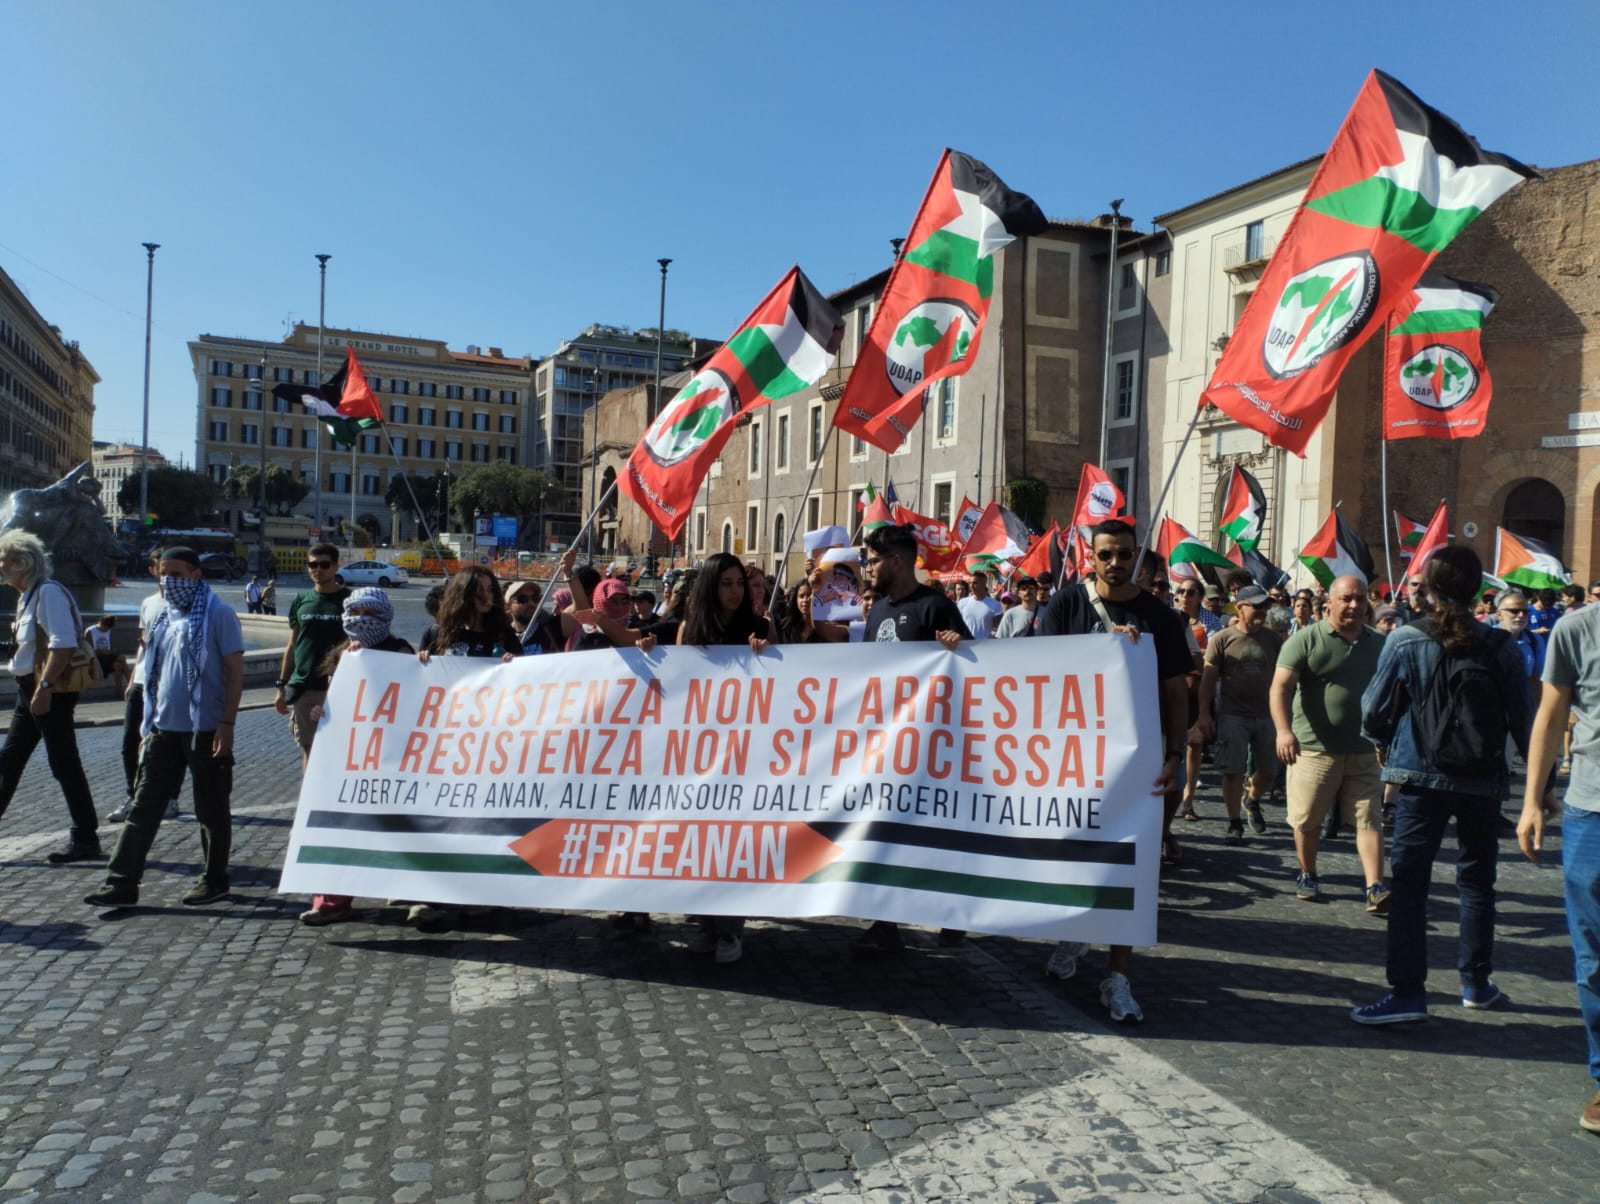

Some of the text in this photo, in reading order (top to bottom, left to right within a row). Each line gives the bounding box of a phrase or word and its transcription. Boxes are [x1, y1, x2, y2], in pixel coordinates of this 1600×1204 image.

[328, 338, 420, 355] LE GRAND HOTEL
[889, 361, 922, 384] UDAP
[1409, 386, 1433, 396] UDAP
[353, 673, 1106, 729] LA RESISTENZA NON SI ARRESTA!
[345, 727, 1106, 788] LA RESISTENZA NON SI PROCESSA!
[338, 778, 1102, 830] LIBERTA' PER ANAN, ALI E MANSOUR DALLE CARCERI ITALIANE
[558, 823, 788, 880] #FREEANAN
